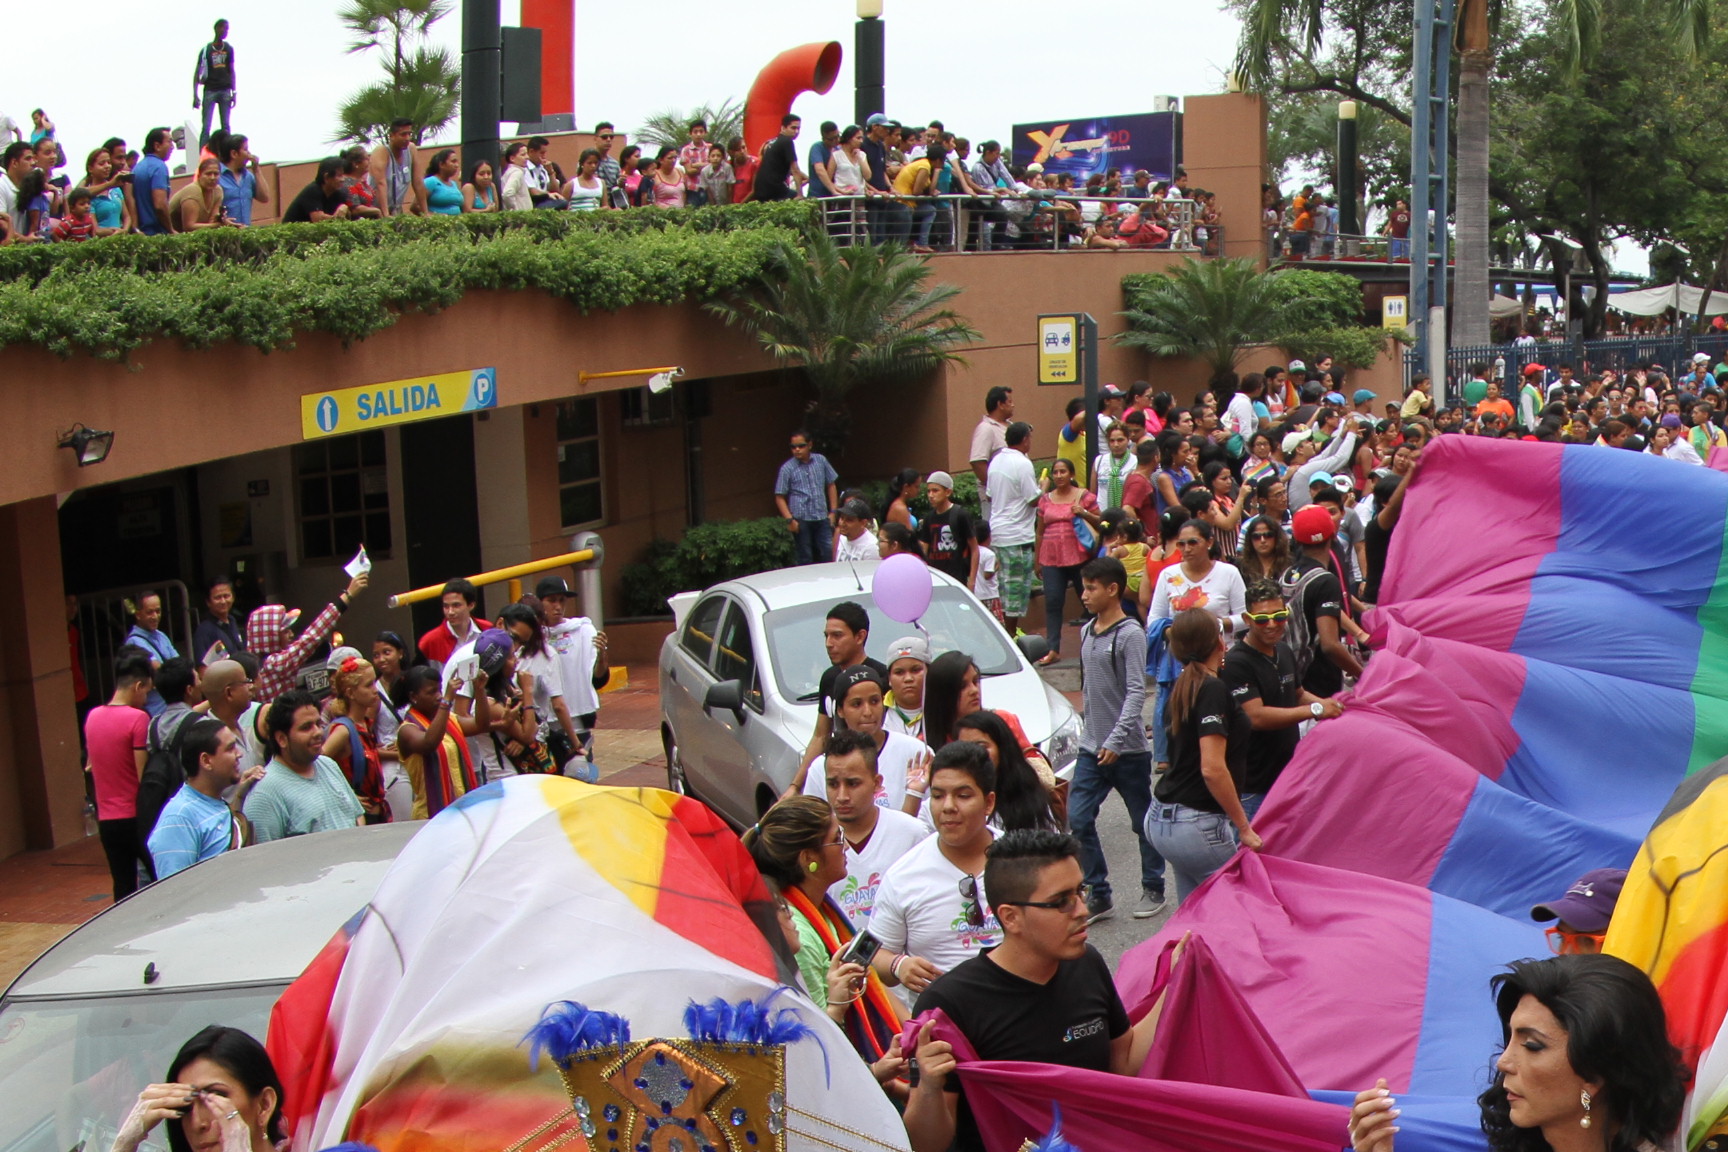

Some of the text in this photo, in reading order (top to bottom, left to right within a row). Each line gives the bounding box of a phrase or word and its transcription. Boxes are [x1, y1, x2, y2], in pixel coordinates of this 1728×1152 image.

[356, 377, 490, 421] SALIDA P
[849, 671, 869, 683] NY
